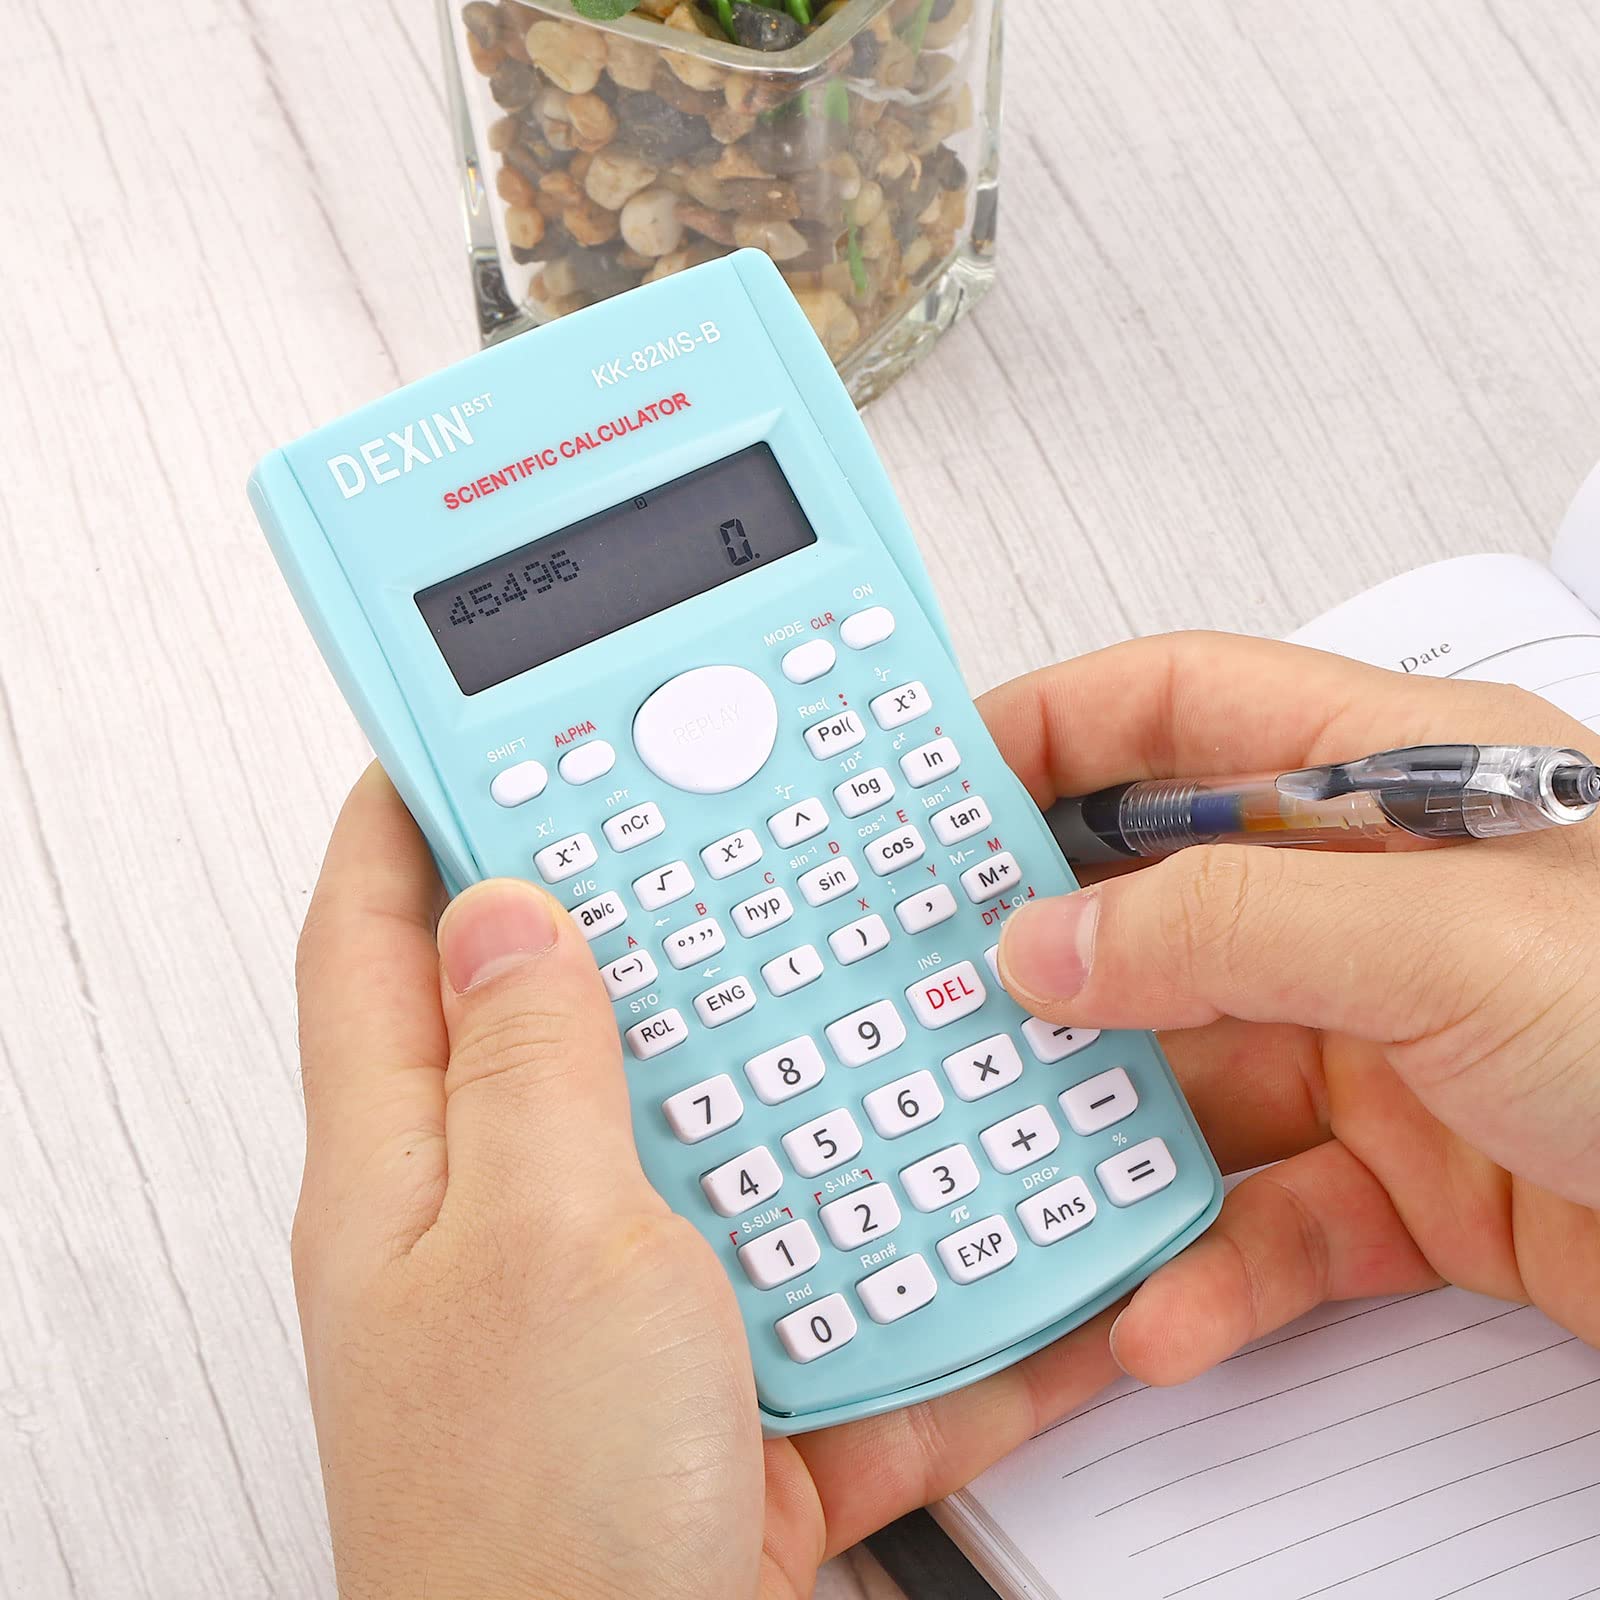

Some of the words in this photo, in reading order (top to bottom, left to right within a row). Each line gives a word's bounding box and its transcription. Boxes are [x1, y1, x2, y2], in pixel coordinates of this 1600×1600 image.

[591, 321, 721, 388] KK-82MS-B
[327, 405, 475, 499] DEXIN
[462, 393, 494, 417] BST
[443, 448, 558, 511] SCIENTIFIC
[559, 392, 691, 460] CALCULATOR
[852, 584, 874, 600] ON
[763, 621, 804, 646] MODE
[810, 612, 835, 630] CLR
[1399, 642, 1452, 673] Date
[554, 720, 597, 747] ALPHA
[673, 704, 741, 745] REPLAY
[488, 737, 527, 763] SHIFT
[606, 788, 630, 807] nPr
[851, 778, 881, 798] log
[621, 813, 651, 835] nCr
[950, 807, 981, 829] tan
[882, 837, 914, 859] cos
[987, 838, 1002, 852] M
[818, 870, 847, 892] sin
[978, 864, 1010, 888] M+
[745, 897, 781, 921] hyp
[982, 908, 999, 925] DT
[917, 953, 942, 970] INS
[630, 993, 658, 1014] STO
[707, 985, 746, 1012] ENG
[926, 976, 974, 1010] DEL
[640, 1018, 674, 1043] RCL
[858, 1021, 881, 1050] 9
[777, 1057, 801, 1085] 8
[692, 1095, 712, 1125] 7
[897, 1089, 920, 1118] 6
[812, 1128, 837, 1159] 5
[1112, 1132, 1128, 1146] %
[739, 1169, 760, 1196] 4
[824, 1168, 863, 1193] S-VAR
[932, 1165, 956, 1195] 3
[741, 1207, 783, 1234] S-SUM
[854, 1204, 878, 1233] 2
[1043, 1196, 1086, 1229] Ans
[775, 1240, 795, 1267] 1
[860, 1242, 897, 1268] Ran#
[958, 1232, 1002, 1267] EXP
[785, 1284, 813, 1304] Rnd
[810, 1315, 833, 1343] 0
